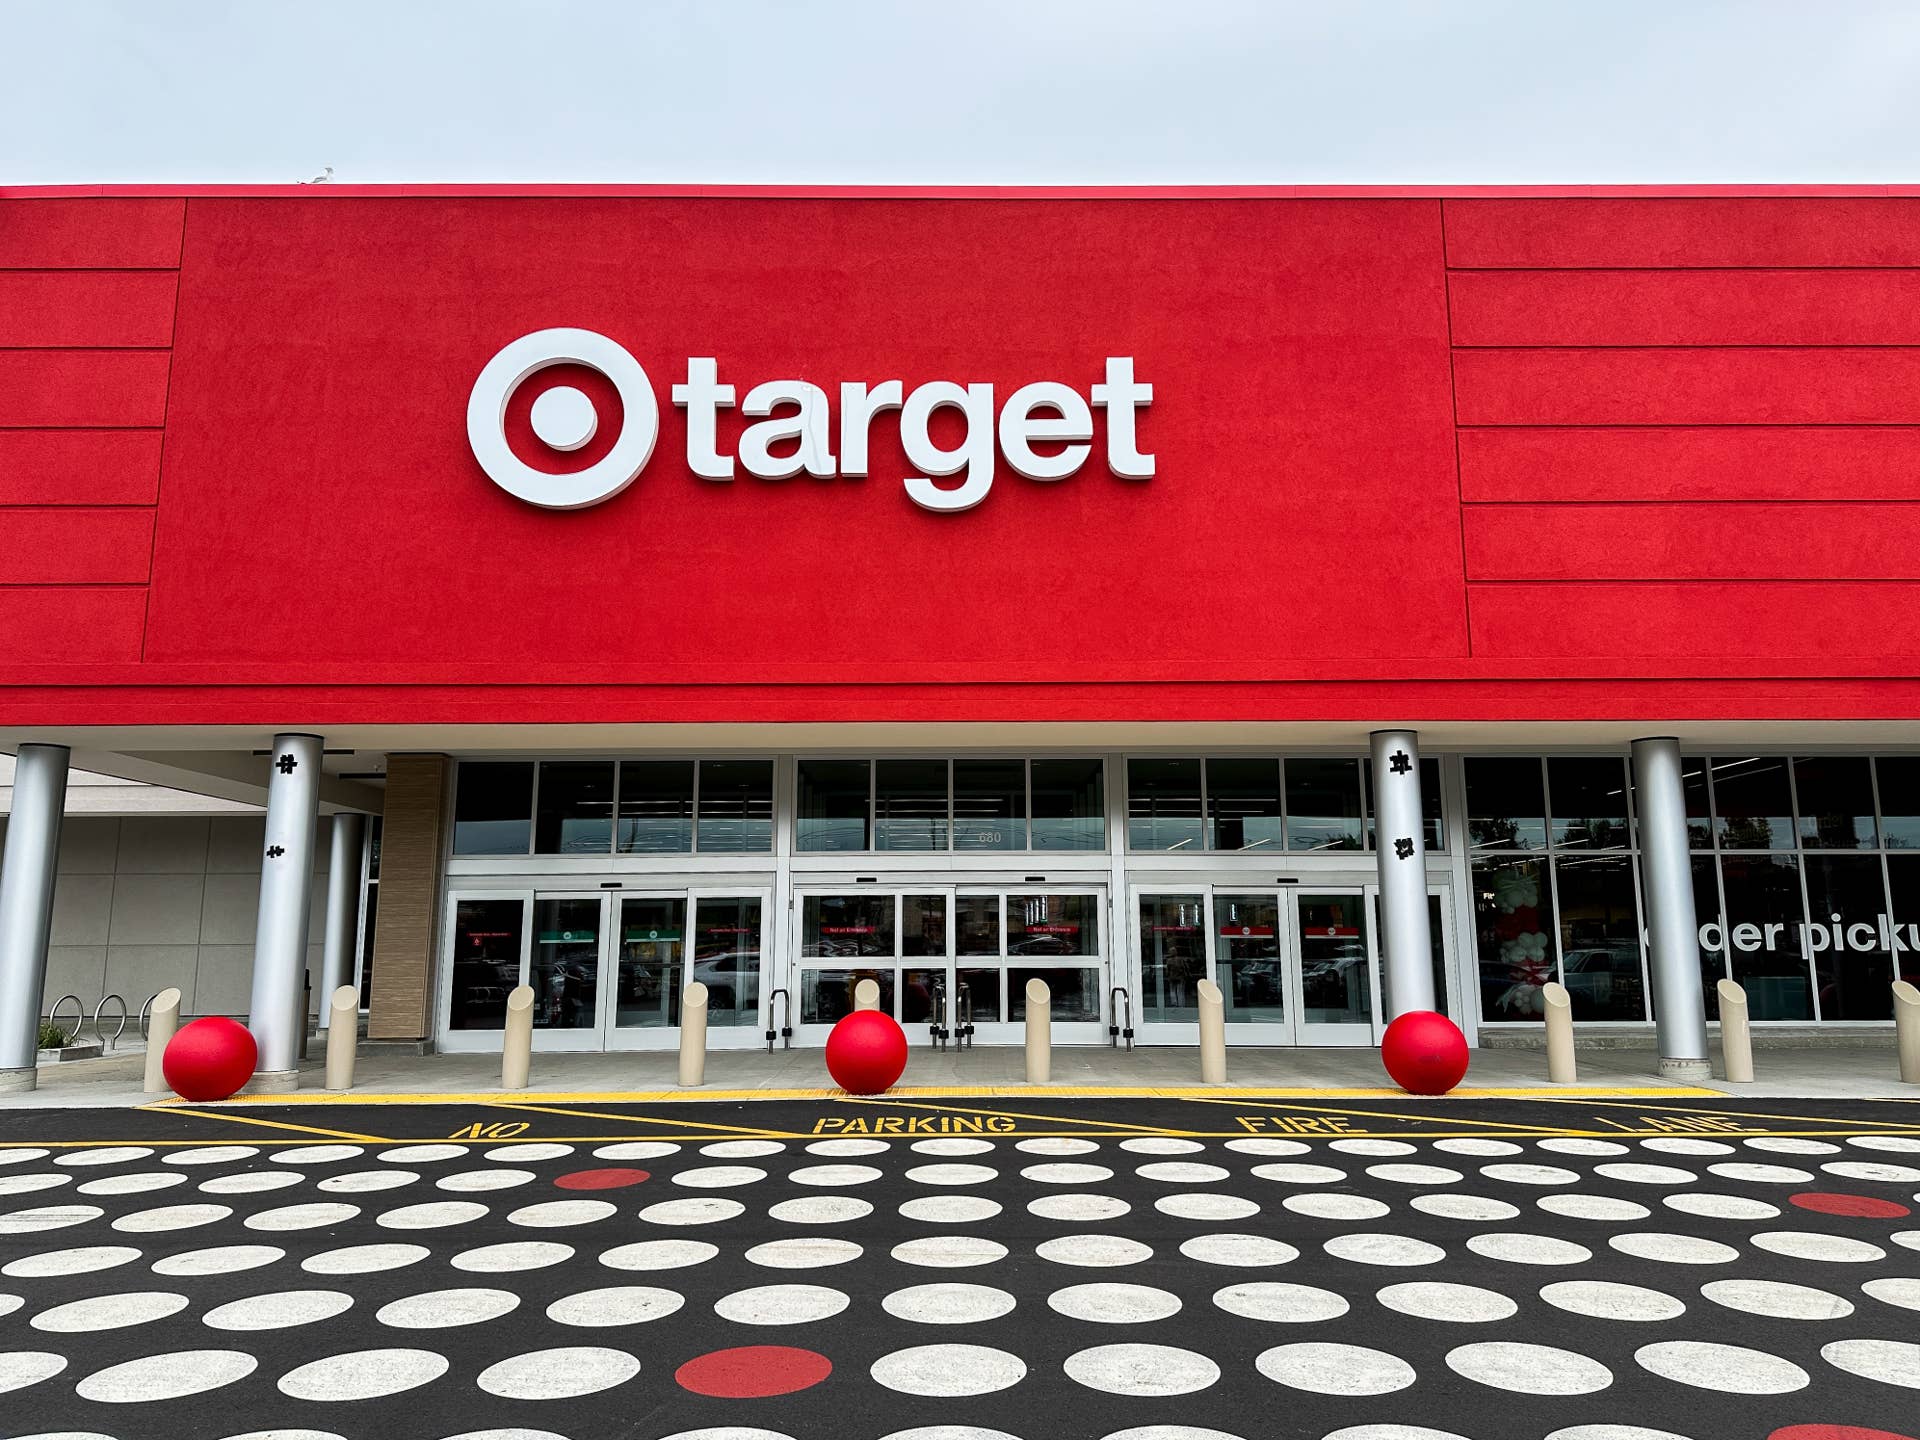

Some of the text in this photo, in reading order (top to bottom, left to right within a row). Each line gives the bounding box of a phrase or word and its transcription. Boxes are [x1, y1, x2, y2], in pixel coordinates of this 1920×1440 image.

[672, 356, 1155, 513] target
[979, 831, 1001, 843] 680
[447, 1116, 1770, 1139] NO PARKING FIRE LANE
